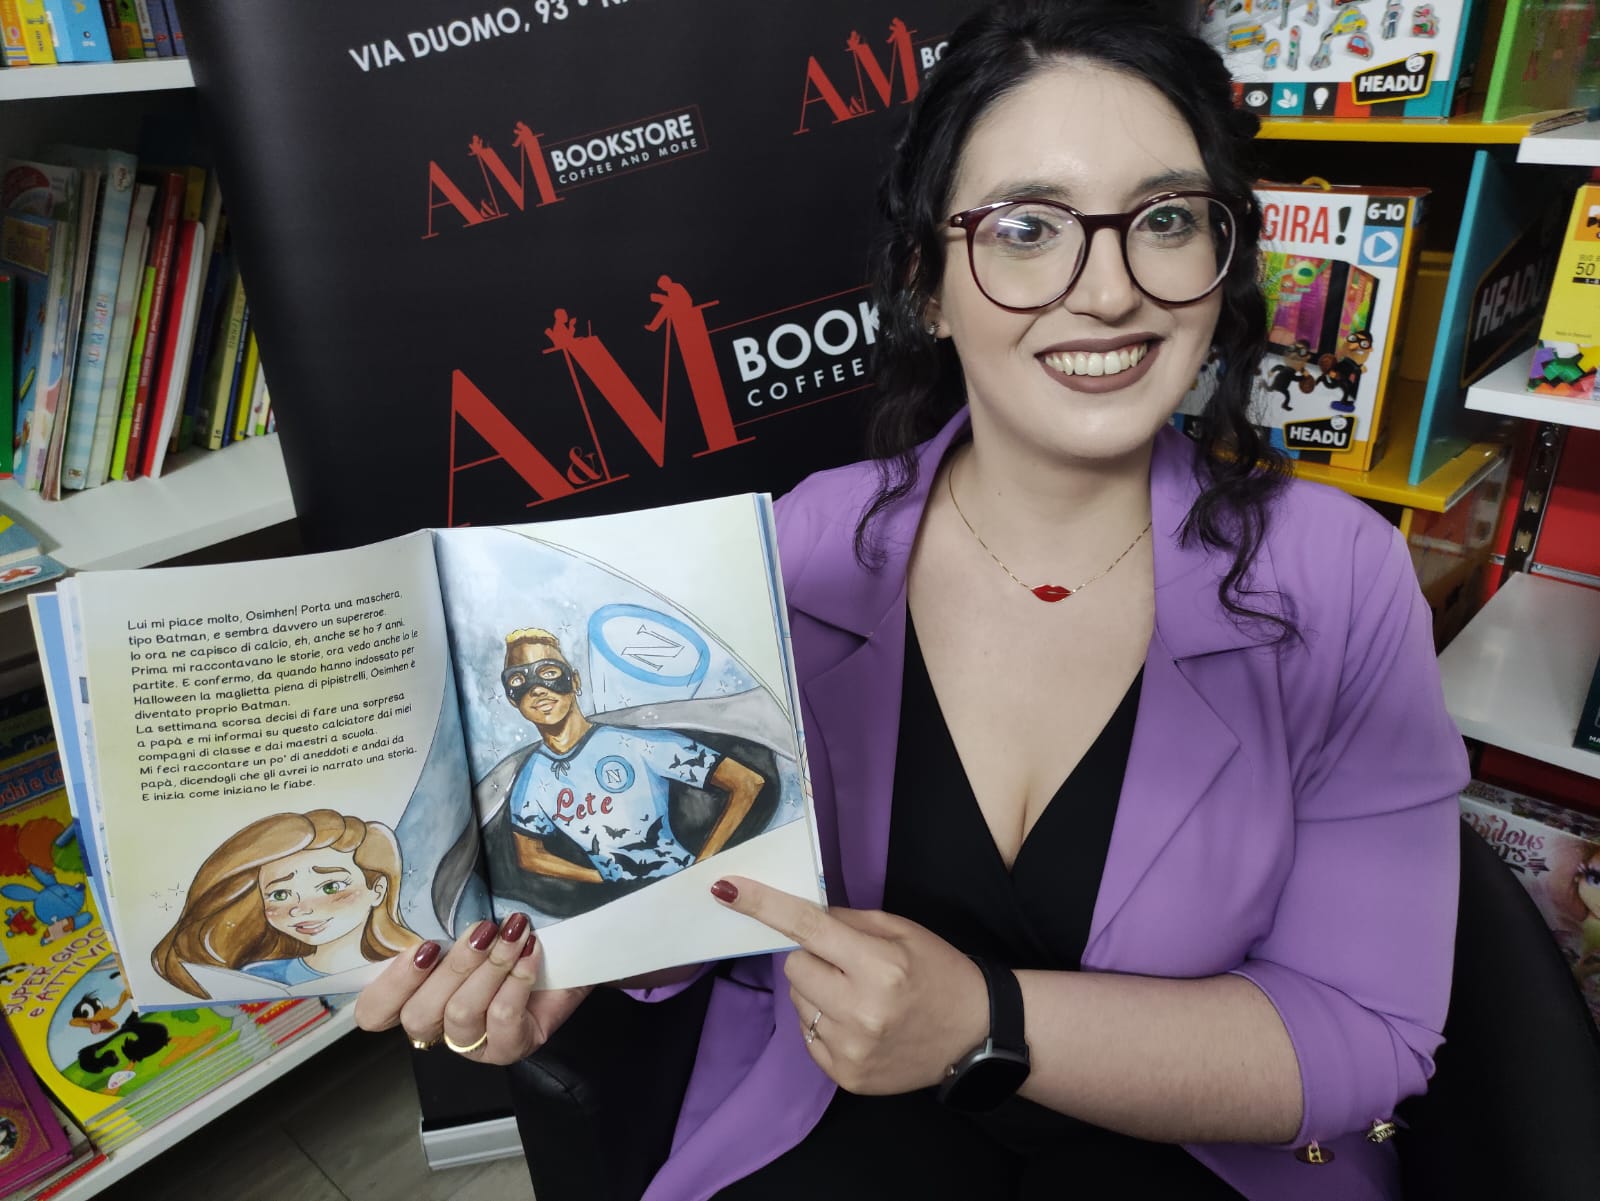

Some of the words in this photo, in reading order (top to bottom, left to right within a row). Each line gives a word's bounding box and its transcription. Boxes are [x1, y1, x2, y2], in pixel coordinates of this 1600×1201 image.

[349, 39, 405, 72] VIA
[408, 7, 530, 58] DUOMO,
[535, 0, 569, 24] 93
[1359, 75, 1424, 92] HEADU
[551, 114, 694, 172] BOOKSTORE
[558, 161, 613, 184] COFFEE
[620, 152, 651, 169] AND
[658, 138, 699, 157] MORE
[1367, 202, 1405, 221] 6-10
[1575, 262, 1595, 276] 50
[747, 357, 865, 407] COFFEE
[1289, 425, 1347, 446] HEADU
[127, 619, 147, 631] Lui
[151, 618, 165, 629] mi
[168, 617, 203, 630] piace
[207, 613, 242, 624] molto,
[245, 605, 297, 621] Osimhen!
[301, 602, 331, 615] Porta
[334, 599, 353, 610] una
[128, 635, 152, 648] tipo
[156, 633, 210, 644] Batman,
[213, 632, 221, 640] e
[224, 626, 269, 639] sembra
[272, 621, 318, 634] davvero
[321, 618, 334, 627] un
[131, 665, 168, 676] Prima
[172, 663, 186, 673] mi
[189, 657, 273, 672] raccontavano
[276, 654, 287, 664] le
[290, 649, 324, 661] storie,
[326, 646, 345, 656] ora
[347, 640, 371, 653] vedo
[373, 635, 400, 648] anche
[411, 629, 418, 639] le
[145, 651, 167, 660] ora
[171, 650, 186, 658] ne
[190, 645, 237, 659] capisco
[240, 642, 251, 652] di
[254, 638, 291, 651] calcio,
[294, 635, 310, 646] eh,
[313, 631, 346, 643] anche
[348, 629, 360, 637] se
[363, 625, 375, 635] ho
[376, 622, 382, 632] 7
[132, 680, 178, 694] partite.
[182, 678, 191, 687] E
[194, 675, 254, 687] confermo,
[257, 670, 273, 680] da
[276, 664, 317, 680] quando
[320, 661, 352, 673] hanno
[355, 650, 399, 666] indossato
[401, 646, 415, 659] per
[133, 694, 196, 705] Halloween
[200, 691, 211, 701] la
[215, 686, 271, 700] maglietta
[274, 682, 305, 696] piena
[308, 679, 318, 689] di
[321, 674, 367, 689] pipistrelli,
[370, 663, 409, 678] Osimhen
[410, 659, 416, 668] è
[134, 708, 192, 720] diventato
[195, 703, 238, 718] proprio
[241, 700, 291, 711] Batman.
[136, 725, 154, 734] La
[157, 721, 218, 733] settimana
[222, 717, 262, 727] scorsa
[265, 710, 297, 723] decisi
[300, 708, 310, 719] di
[313, 706, 337, 717] fare
[340, 703, 359, 712] una
[362, 692, 405, 708] sorpresa
[137, 740, 146, 748] a
[150, 737, 183, 750] papà
[186, 737, 194, 745] e
[198, 734, 211, 743] mi
[214, 729, 262, 742] informai
[282, 723, 319, 737] questo
[322, 714, 375, 730] calciatore
[377, 708, 393, 720] dai
[394, 703, 412, 716] miei
[138, 749, 196, 763] compagni
[199, 748, 209, 757] di
[212, 746, 251, 756] classe
[265, 740, 283, 751] dai
[286, 734, 328, 749] maestri
[330, 735, 338, 743] a
[342, 727, 378, 741] scuola.
[140, 766, 153, 775] Mi
[156, 764, 180, 774] feci
[183, 760, 249, 772] raccontare
[290, 752, 300, 762] di
[302, 745, 349, 760] aneddoti
[351, 745, 359, 753] e
[361, 737, 390, 751] andai
[392, 735, 404, 744] da
[140, 778, 176, 791] papà,
[179, 773, 236, 786] dicendogli
[239, 771, 260, 781] che
[263, 769, 276, 781] gli
[278, 765, 307, 777] avrei
[310, 764, 319, 773] io
[322, 758, 363, 771] narrato
[366, 754, 385, 764] una
[387, 746, 417, 759] storia.
[142, 793, 150, 802] E
[154, 791, 185, 801] inizia
[189, 789, 220, 799] come
[223, 785, 267, 796] iniziano
[270, 782, 280, 791] le
[283, 779, 316, 790] fiabe.
[552, 788, 614, 822] Lete
[7, 965, 55, 1015] SUPER
[28, 1006, 45, 1017] e
